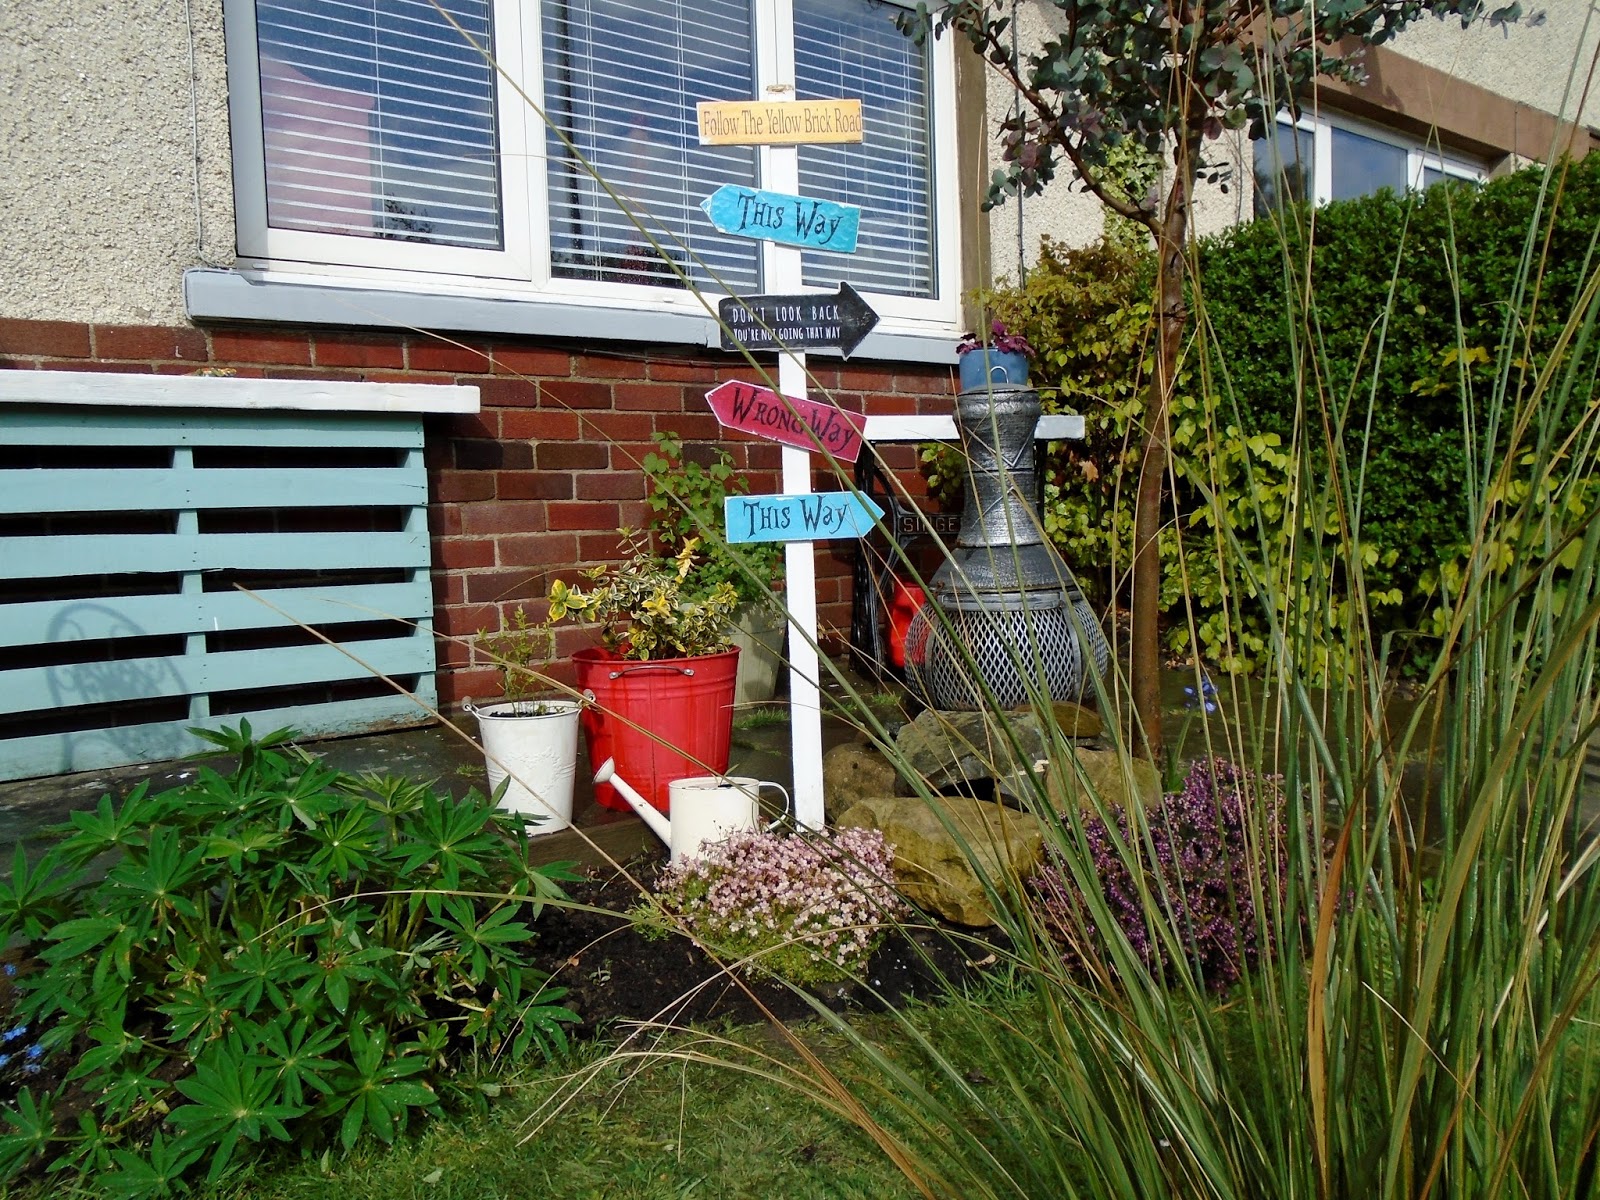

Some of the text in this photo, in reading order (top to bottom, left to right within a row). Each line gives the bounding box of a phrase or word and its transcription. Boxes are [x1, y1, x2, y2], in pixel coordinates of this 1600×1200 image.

[703, 107, 862, 136] Follow The Yellow Brick Road
[794, 200, 843, 245] Way
[733, 305, 839, 323] DON'T LOOK BACK
[733, 326, 841, 342] YOU'RE NOT GOING THAT WAY
[811, 408, 855, 453] Way
[798, 495, 849, 535] Way
